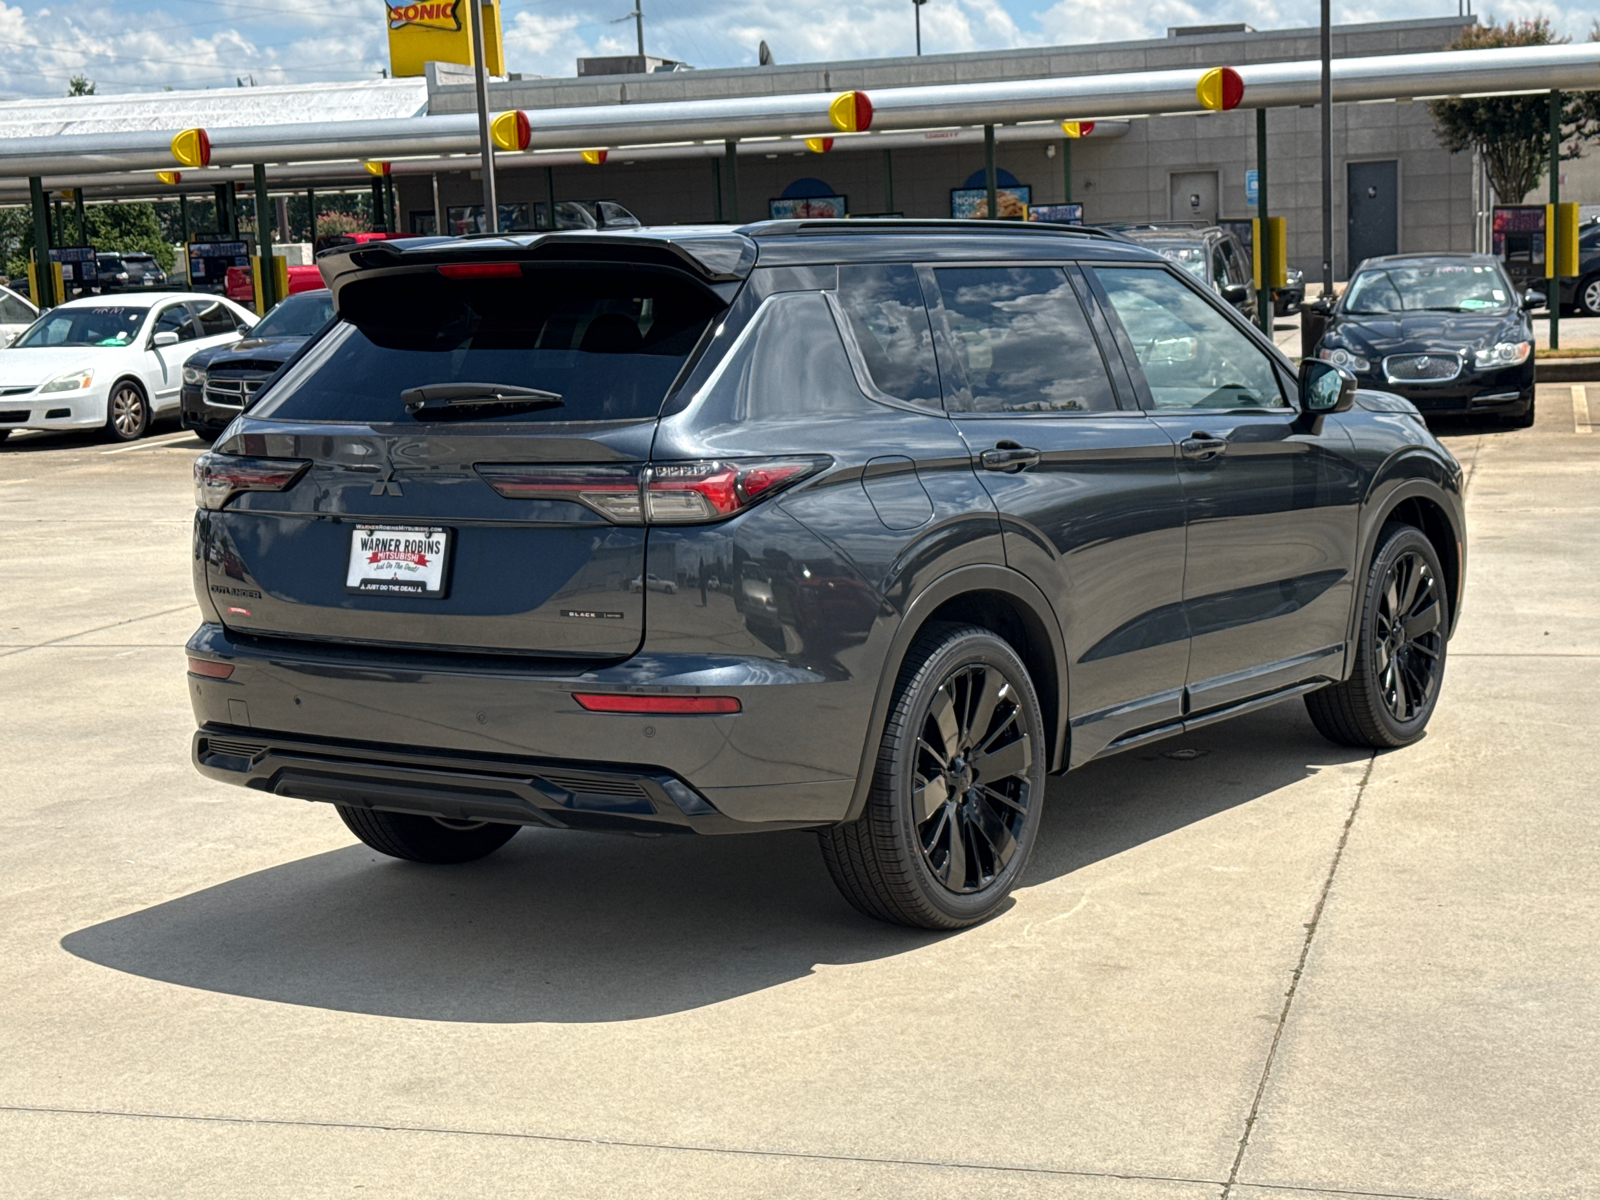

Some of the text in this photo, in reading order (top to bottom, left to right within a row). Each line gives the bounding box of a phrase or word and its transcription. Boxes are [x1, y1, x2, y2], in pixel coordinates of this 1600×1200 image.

[392, 2, 454, 22] SONIC
[360, 537, 441, 555] WARNER ROBINS
[377, 551, 419, 562] MITSUBISHI
[374, 562, 386, 571] Just
[385, 562, 393, 570] Do
[394, 562, 403, 570] The
